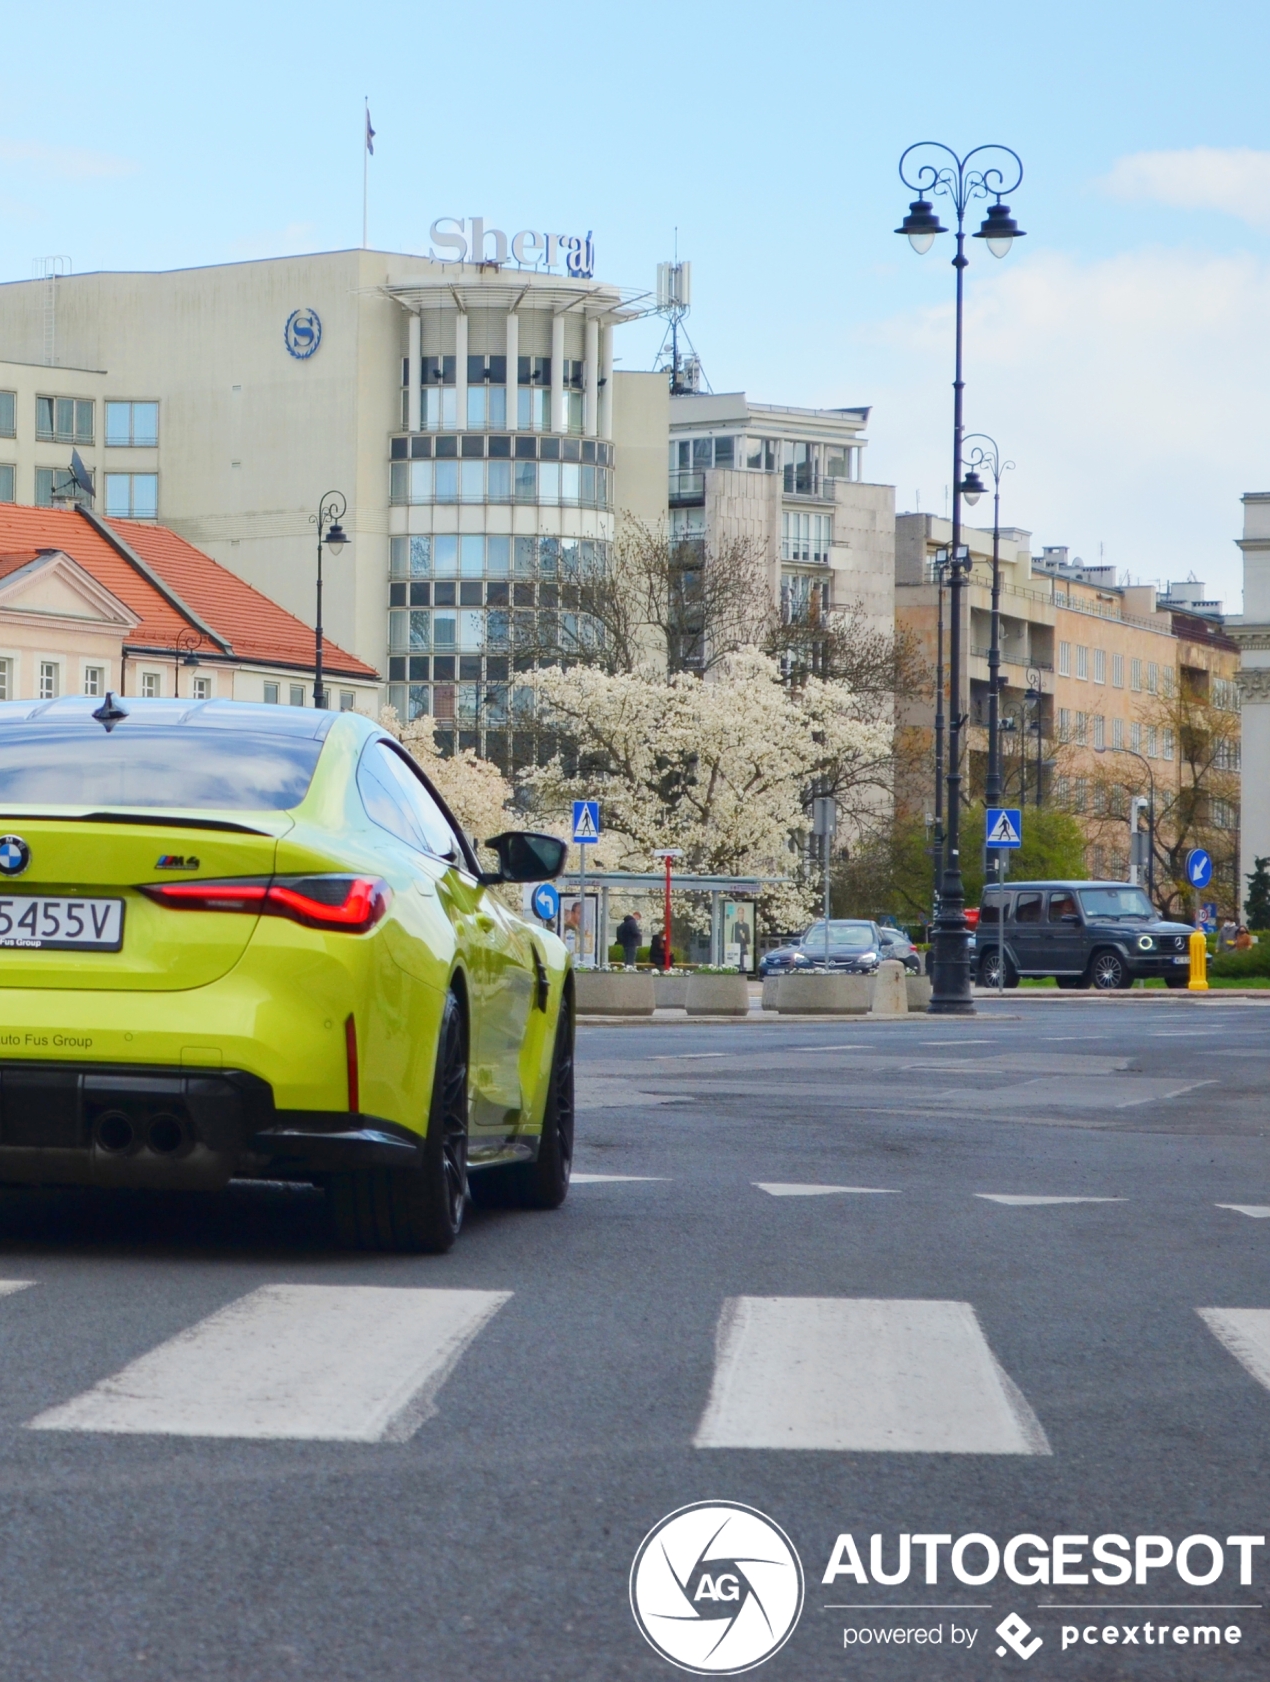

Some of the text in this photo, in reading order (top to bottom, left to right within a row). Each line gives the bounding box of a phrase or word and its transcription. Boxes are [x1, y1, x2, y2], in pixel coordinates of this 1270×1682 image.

[293, 316, 315, 347] S
[0, 938, 15, 947] Fus
[16, 939, 41, 948] Group
[25, 1034, 48, 1046] Fus
[53, 1035, 92, 1049] Group
